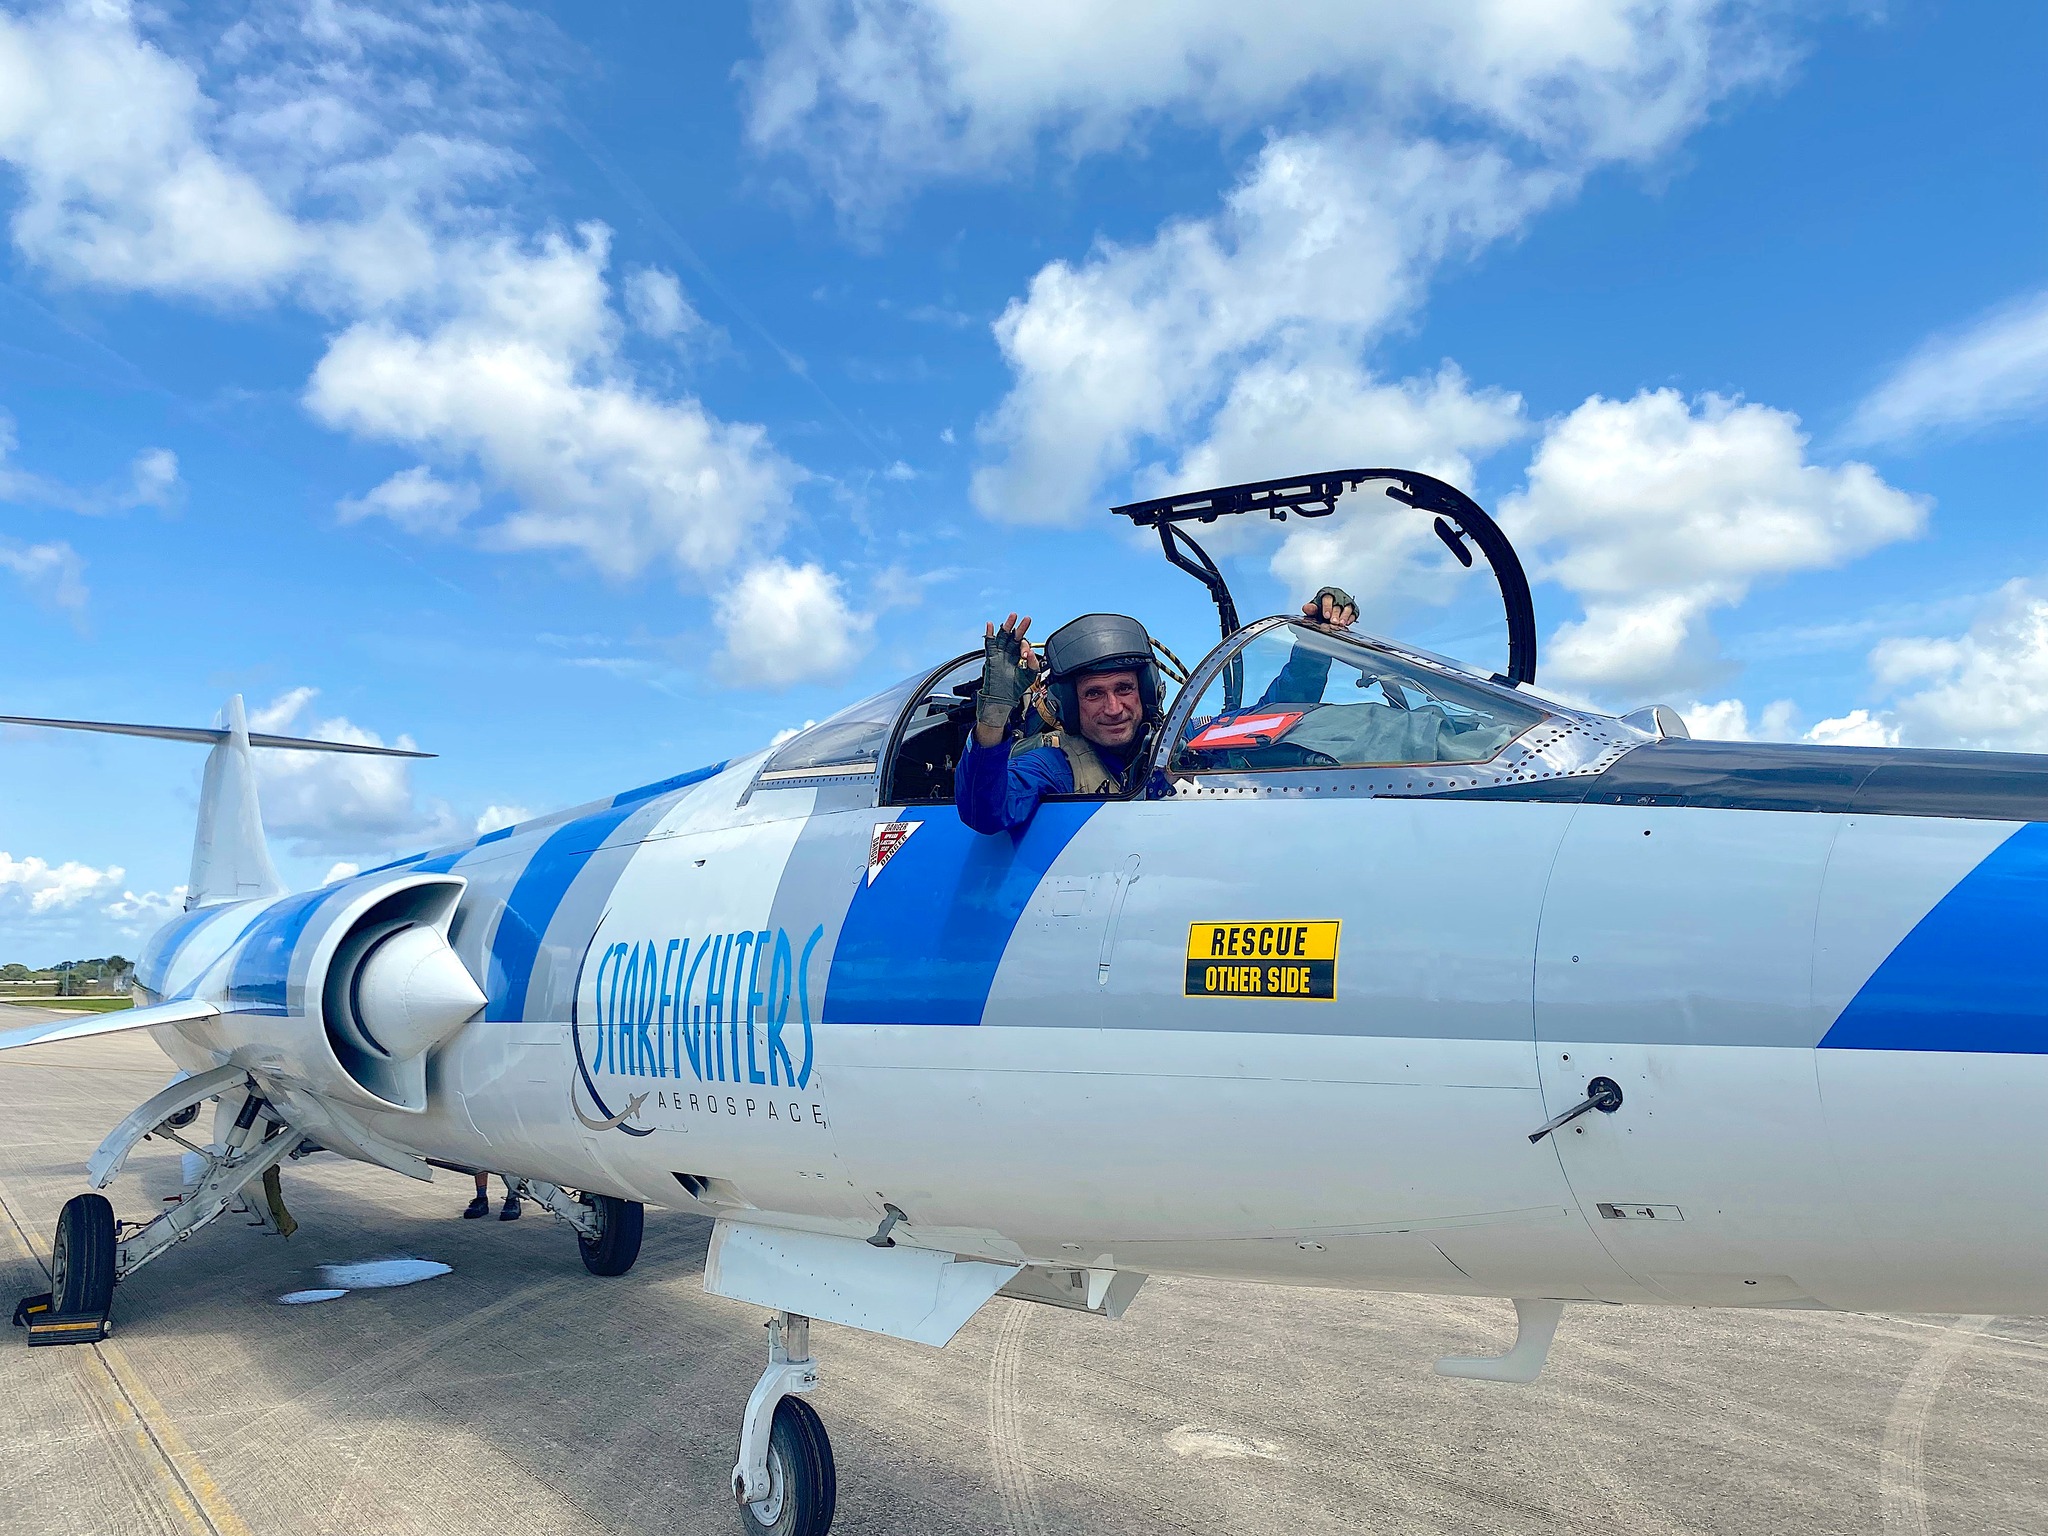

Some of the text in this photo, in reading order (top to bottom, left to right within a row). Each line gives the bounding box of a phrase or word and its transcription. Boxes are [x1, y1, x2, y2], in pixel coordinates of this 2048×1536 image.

[880, 835, 907, 866] DANGER
[1211, 926, 1308, 956] RESCUE
[1205, 966, 1311, 993] OTHER SIDE
[593, 923, 824, 1091] STARFIGHTERS
[657, 1090, 824, 1125] AEROSPACE
